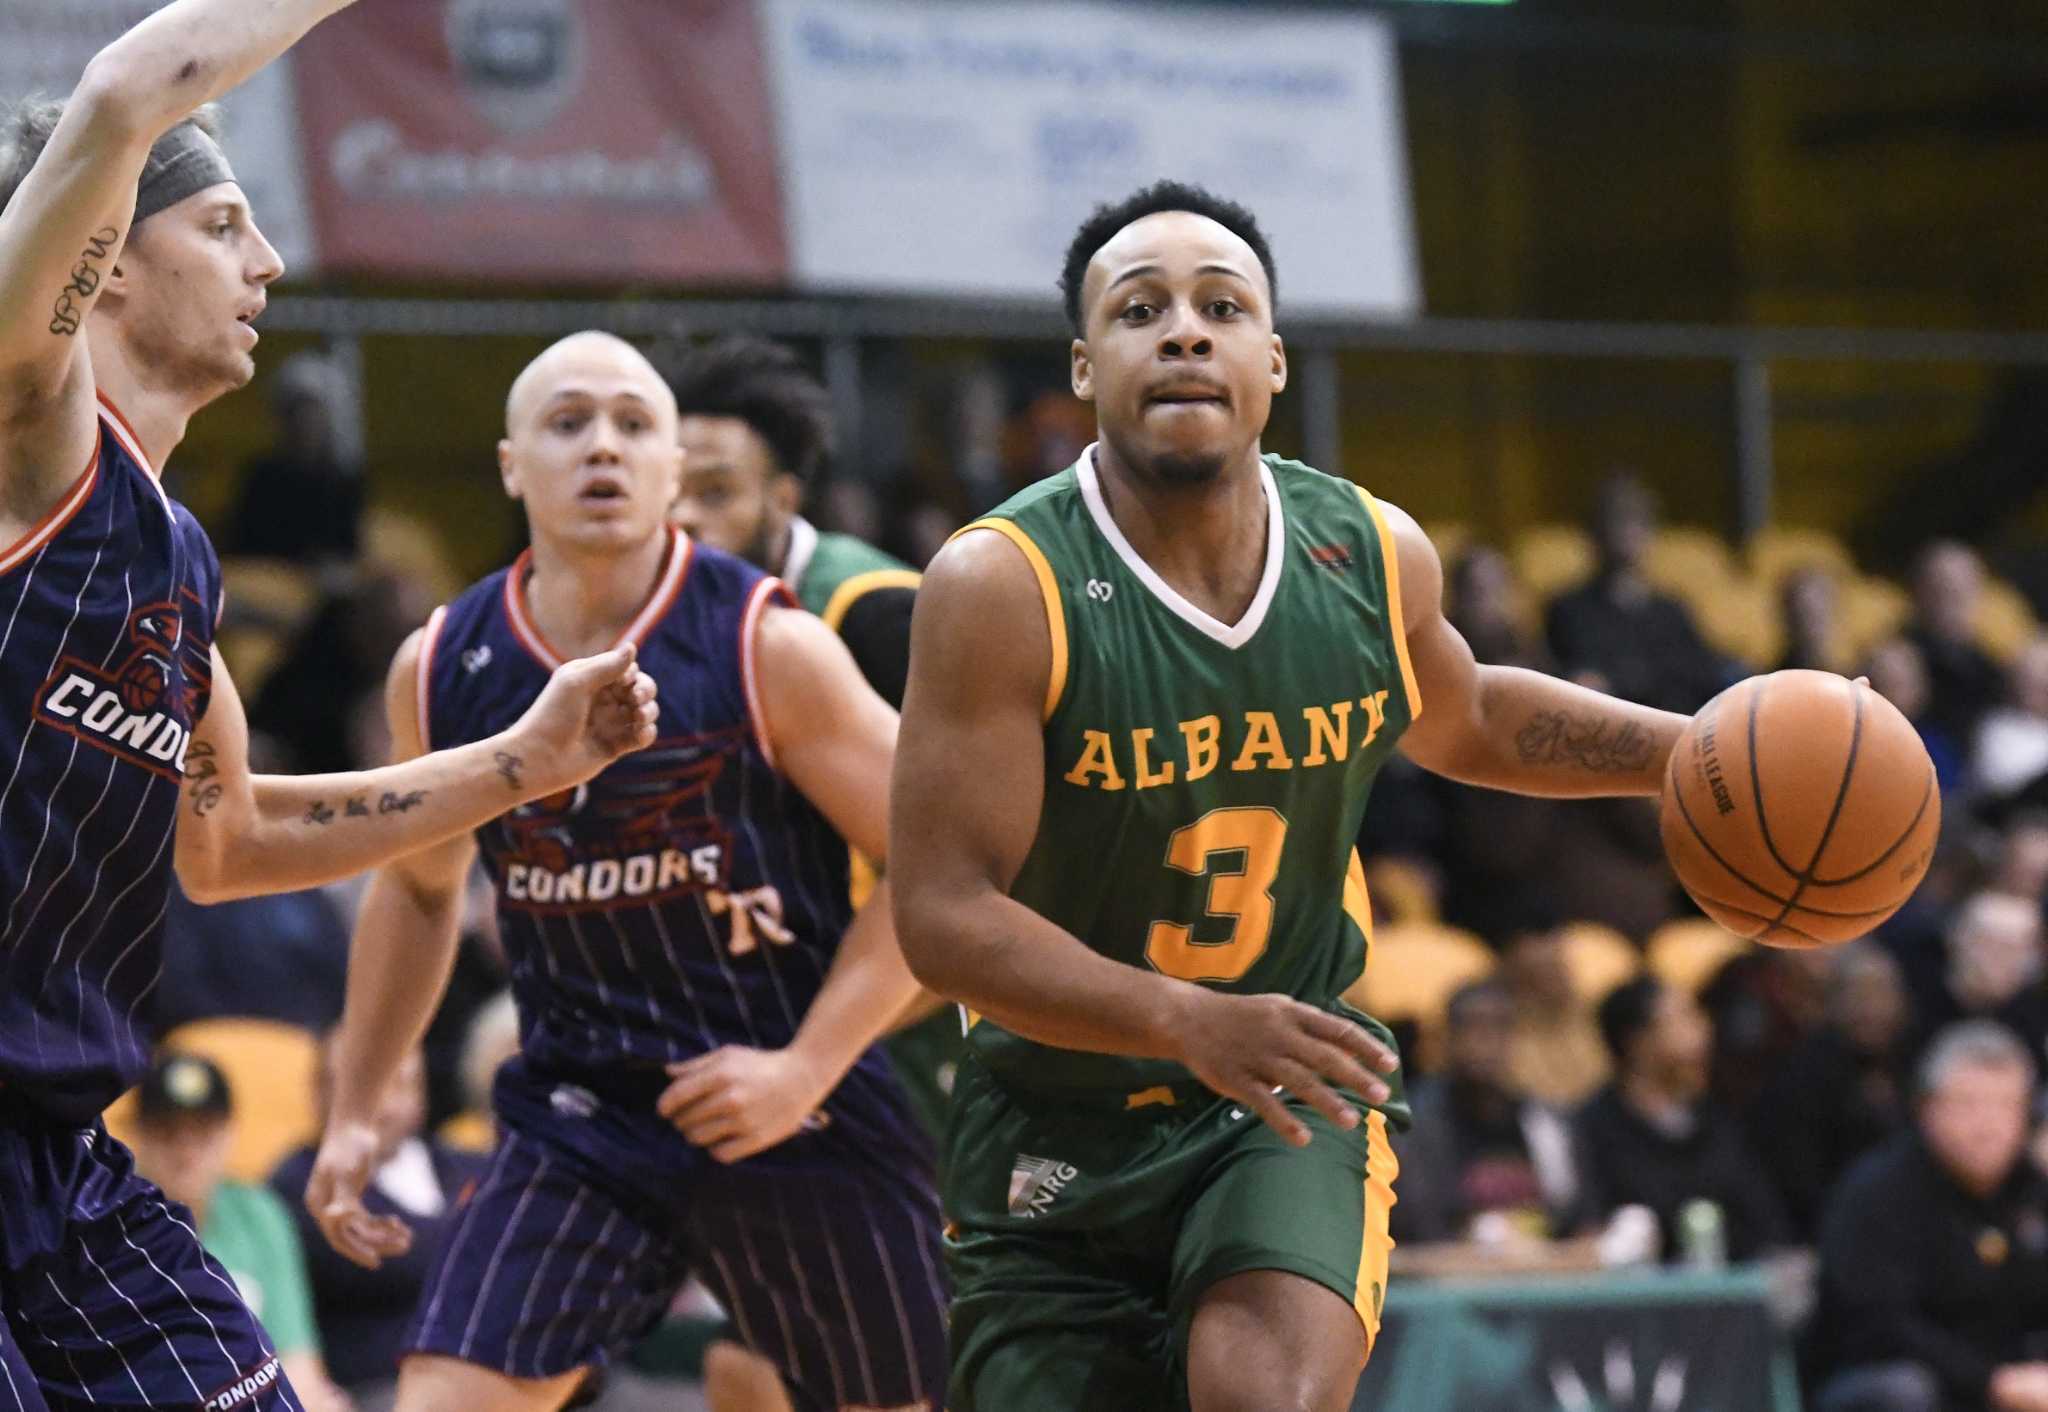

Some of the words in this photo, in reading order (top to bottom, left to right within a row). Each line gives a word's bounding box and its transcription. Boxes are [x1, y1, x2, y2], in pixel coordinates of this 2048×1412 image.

[1064, 690, 1388, 791] ALBANY
[506, 845, 720, 902] CONDORS
[1144, 805, 1288, 983] 3
